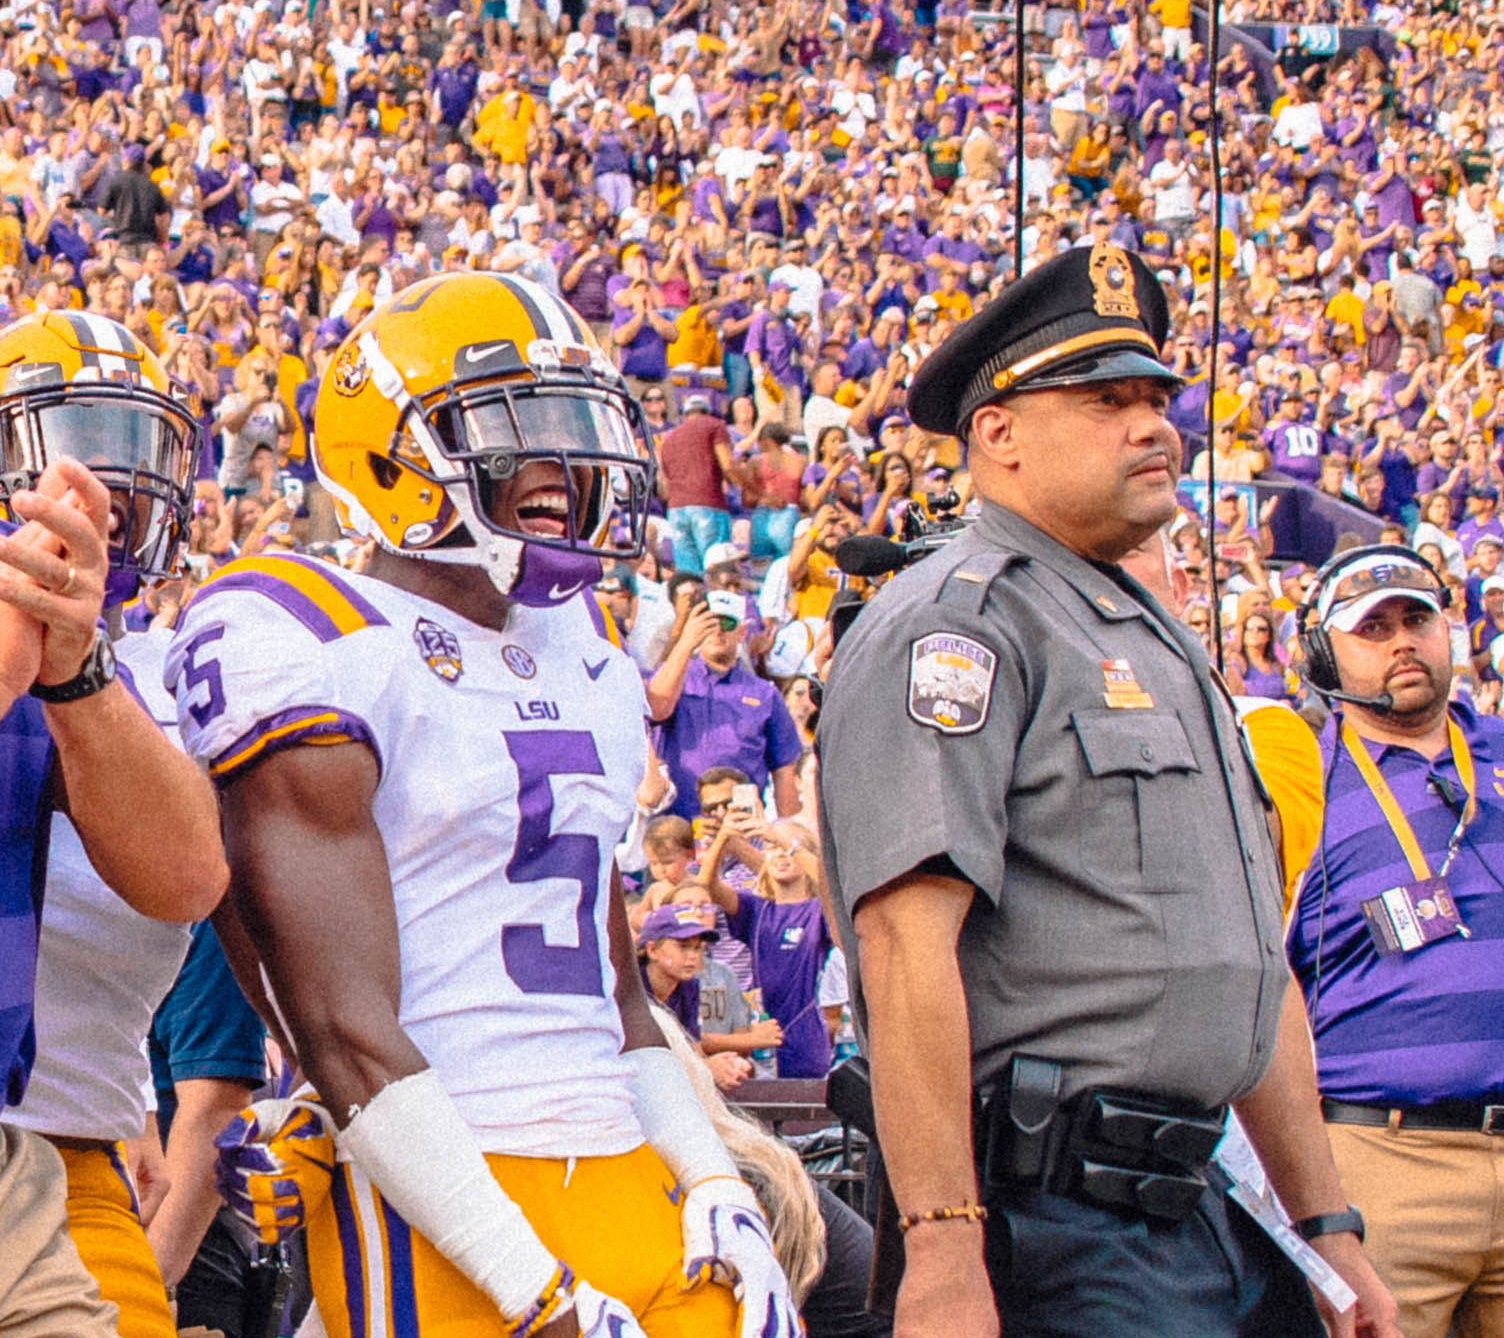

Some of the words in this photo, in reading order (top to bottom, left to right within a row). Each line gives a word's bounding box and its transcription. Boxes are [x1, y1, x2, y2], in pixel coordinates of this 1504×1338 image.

[1285, 427, 1318, 456] 10
[413, 628, 462, 660] 125
[923, 639, 986, 661] POLICE
[181, 623, 228, 729] 5
[513, 700, 560, 721] LSU
[501, 730, 605, 999] 5
